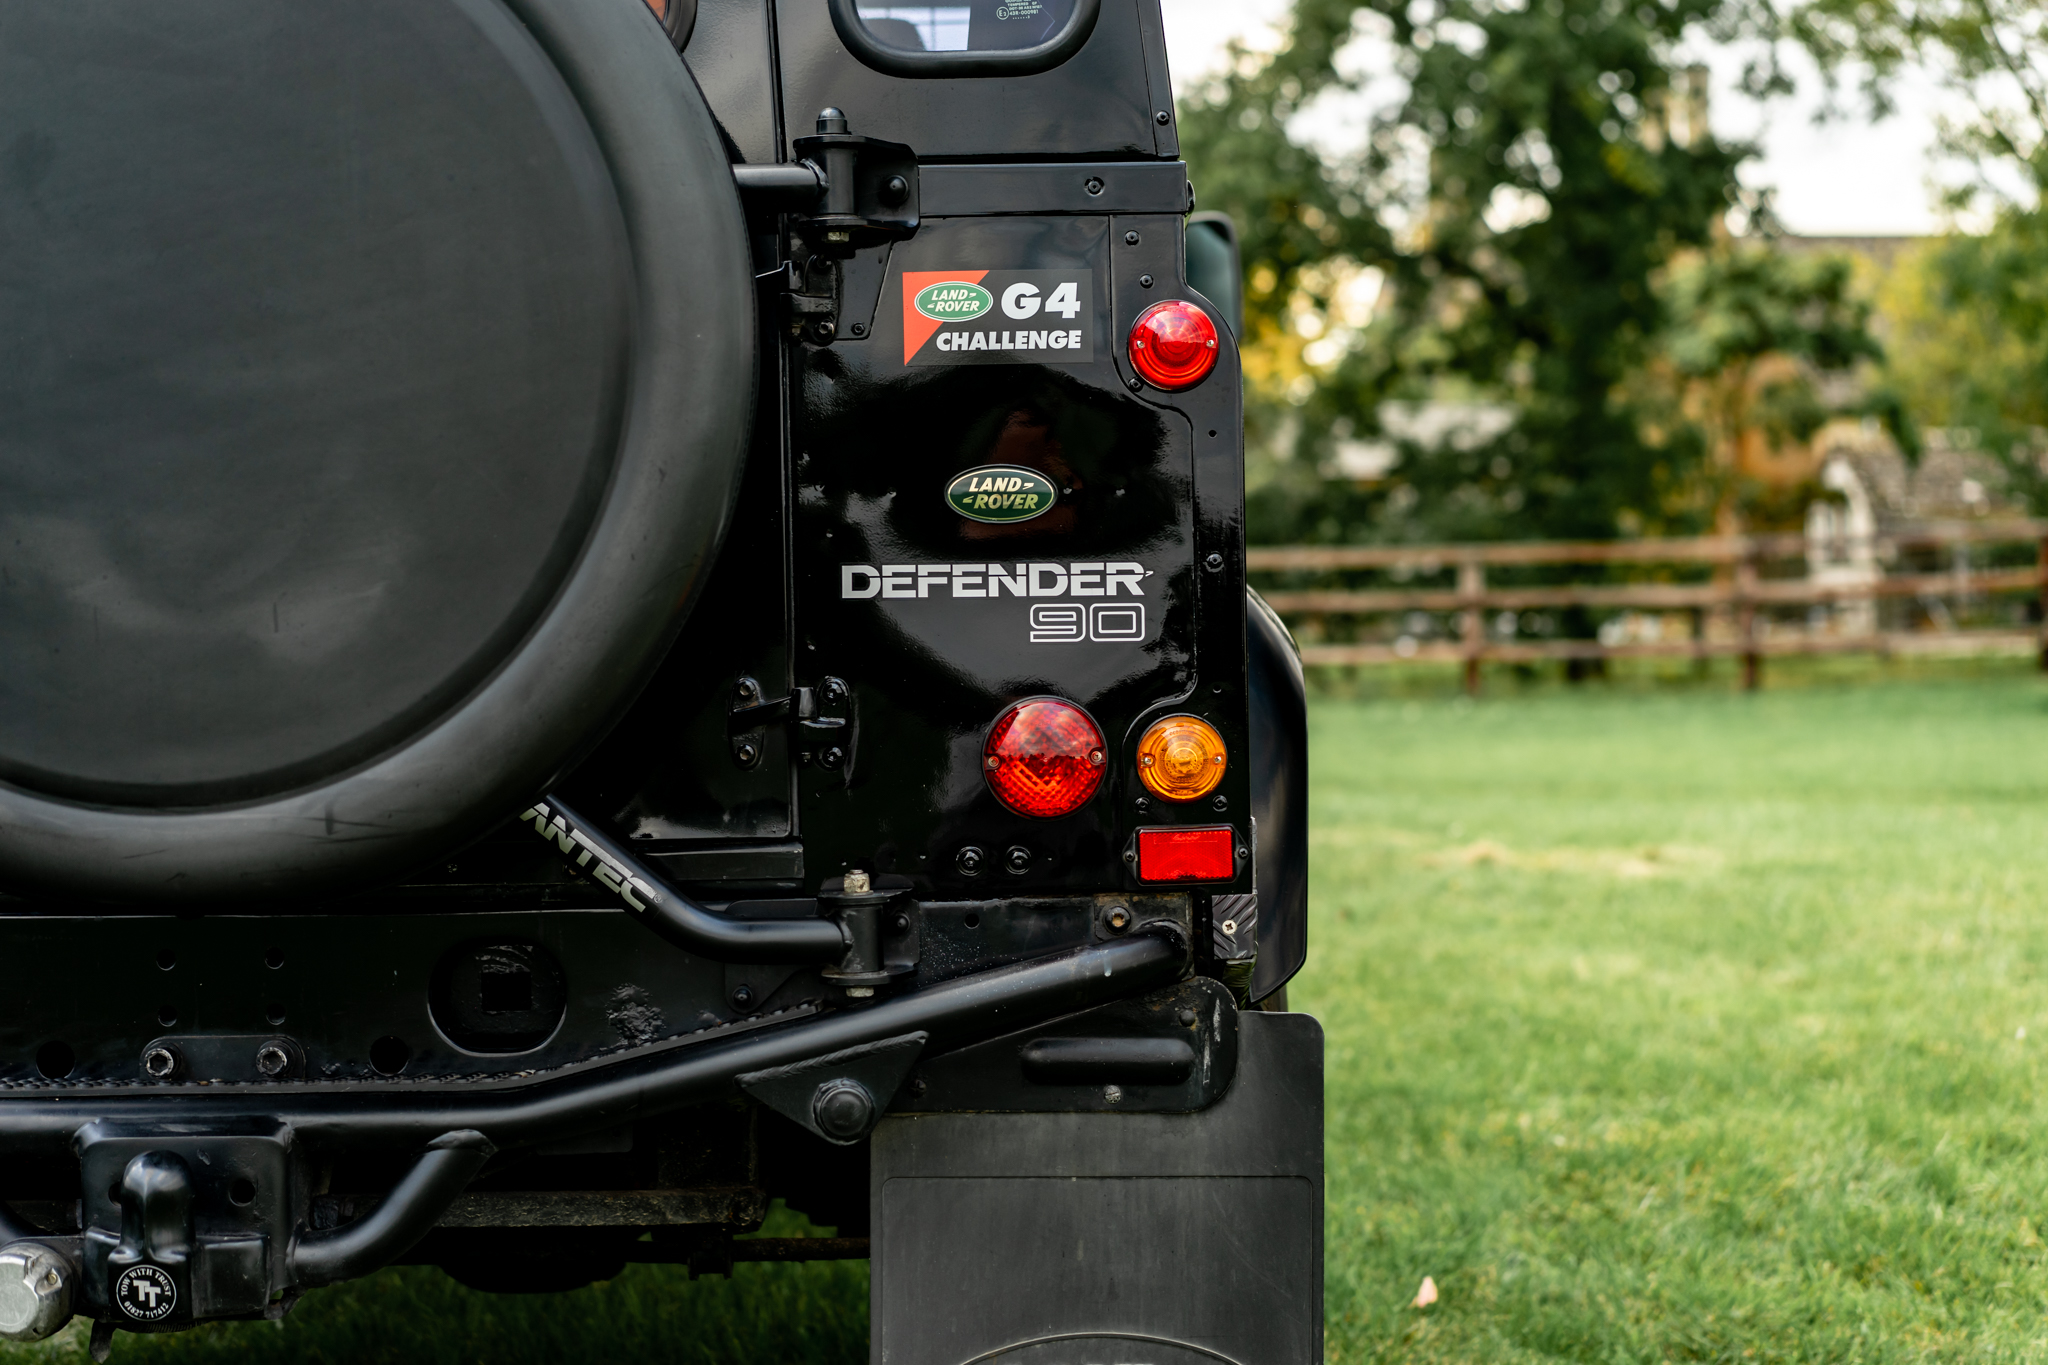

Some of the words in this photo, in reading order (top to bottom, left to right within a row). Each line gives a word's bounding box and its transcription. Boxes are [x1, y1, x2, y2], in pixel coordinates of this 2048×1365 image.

[1001, 282, 1081, 320] G4
[936, 330, 1082, 352] CHALLENGE
[841, 562, 1145, 599] DEFENDER
[1030, 603, 1145, 643] 90
[120, 1276, 131, 1297] TOW
[129, 1268, 153, 1279] WITH
[155, 1271, 172, 1297] TRUST
[124, 1300, 144, 1318] 01827
[145, 1302, 169, 1319] 717412
